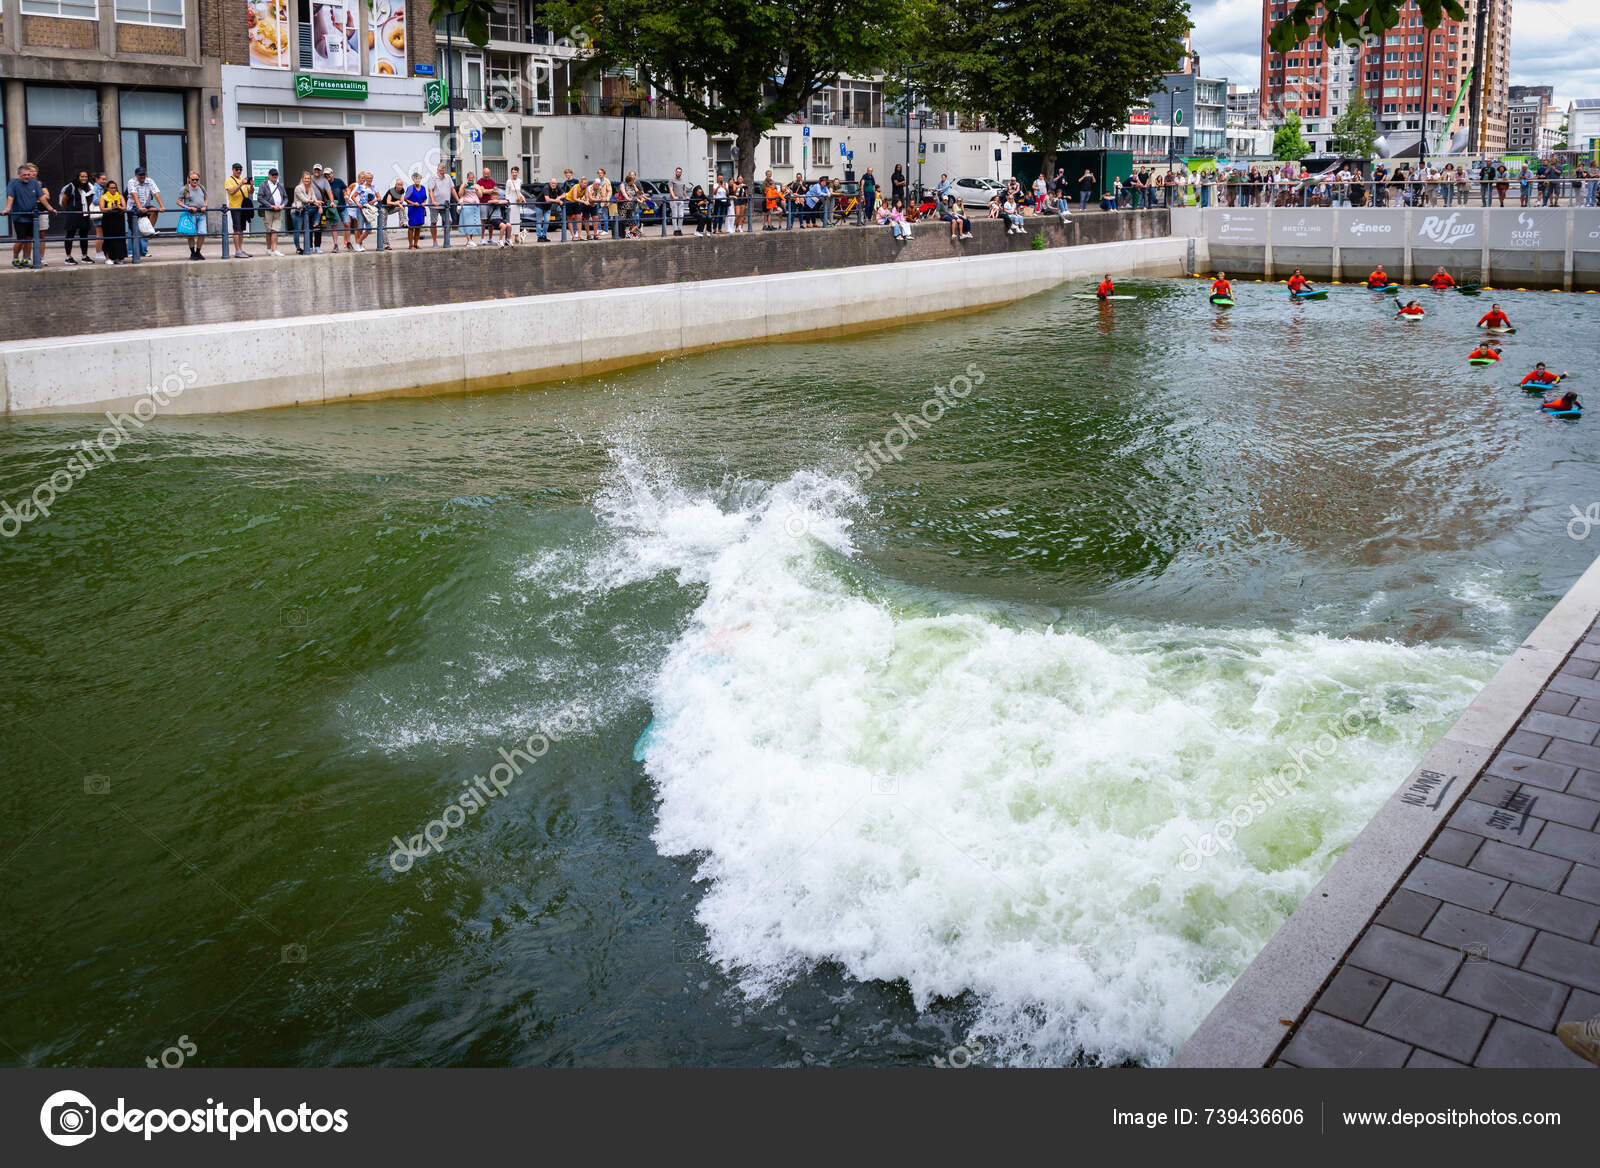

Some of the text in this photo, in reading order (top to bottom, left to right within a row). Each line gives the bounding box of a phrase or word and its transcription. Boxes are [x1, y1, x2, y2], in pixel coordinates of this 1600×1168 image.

[313, 80, 366, 91] Fietsenstalling
[1358, 223, 1391, 233] Eneco
[1511, 231, 1541, 239] SURF
[1511, 239, 1540, 248] LOCH
